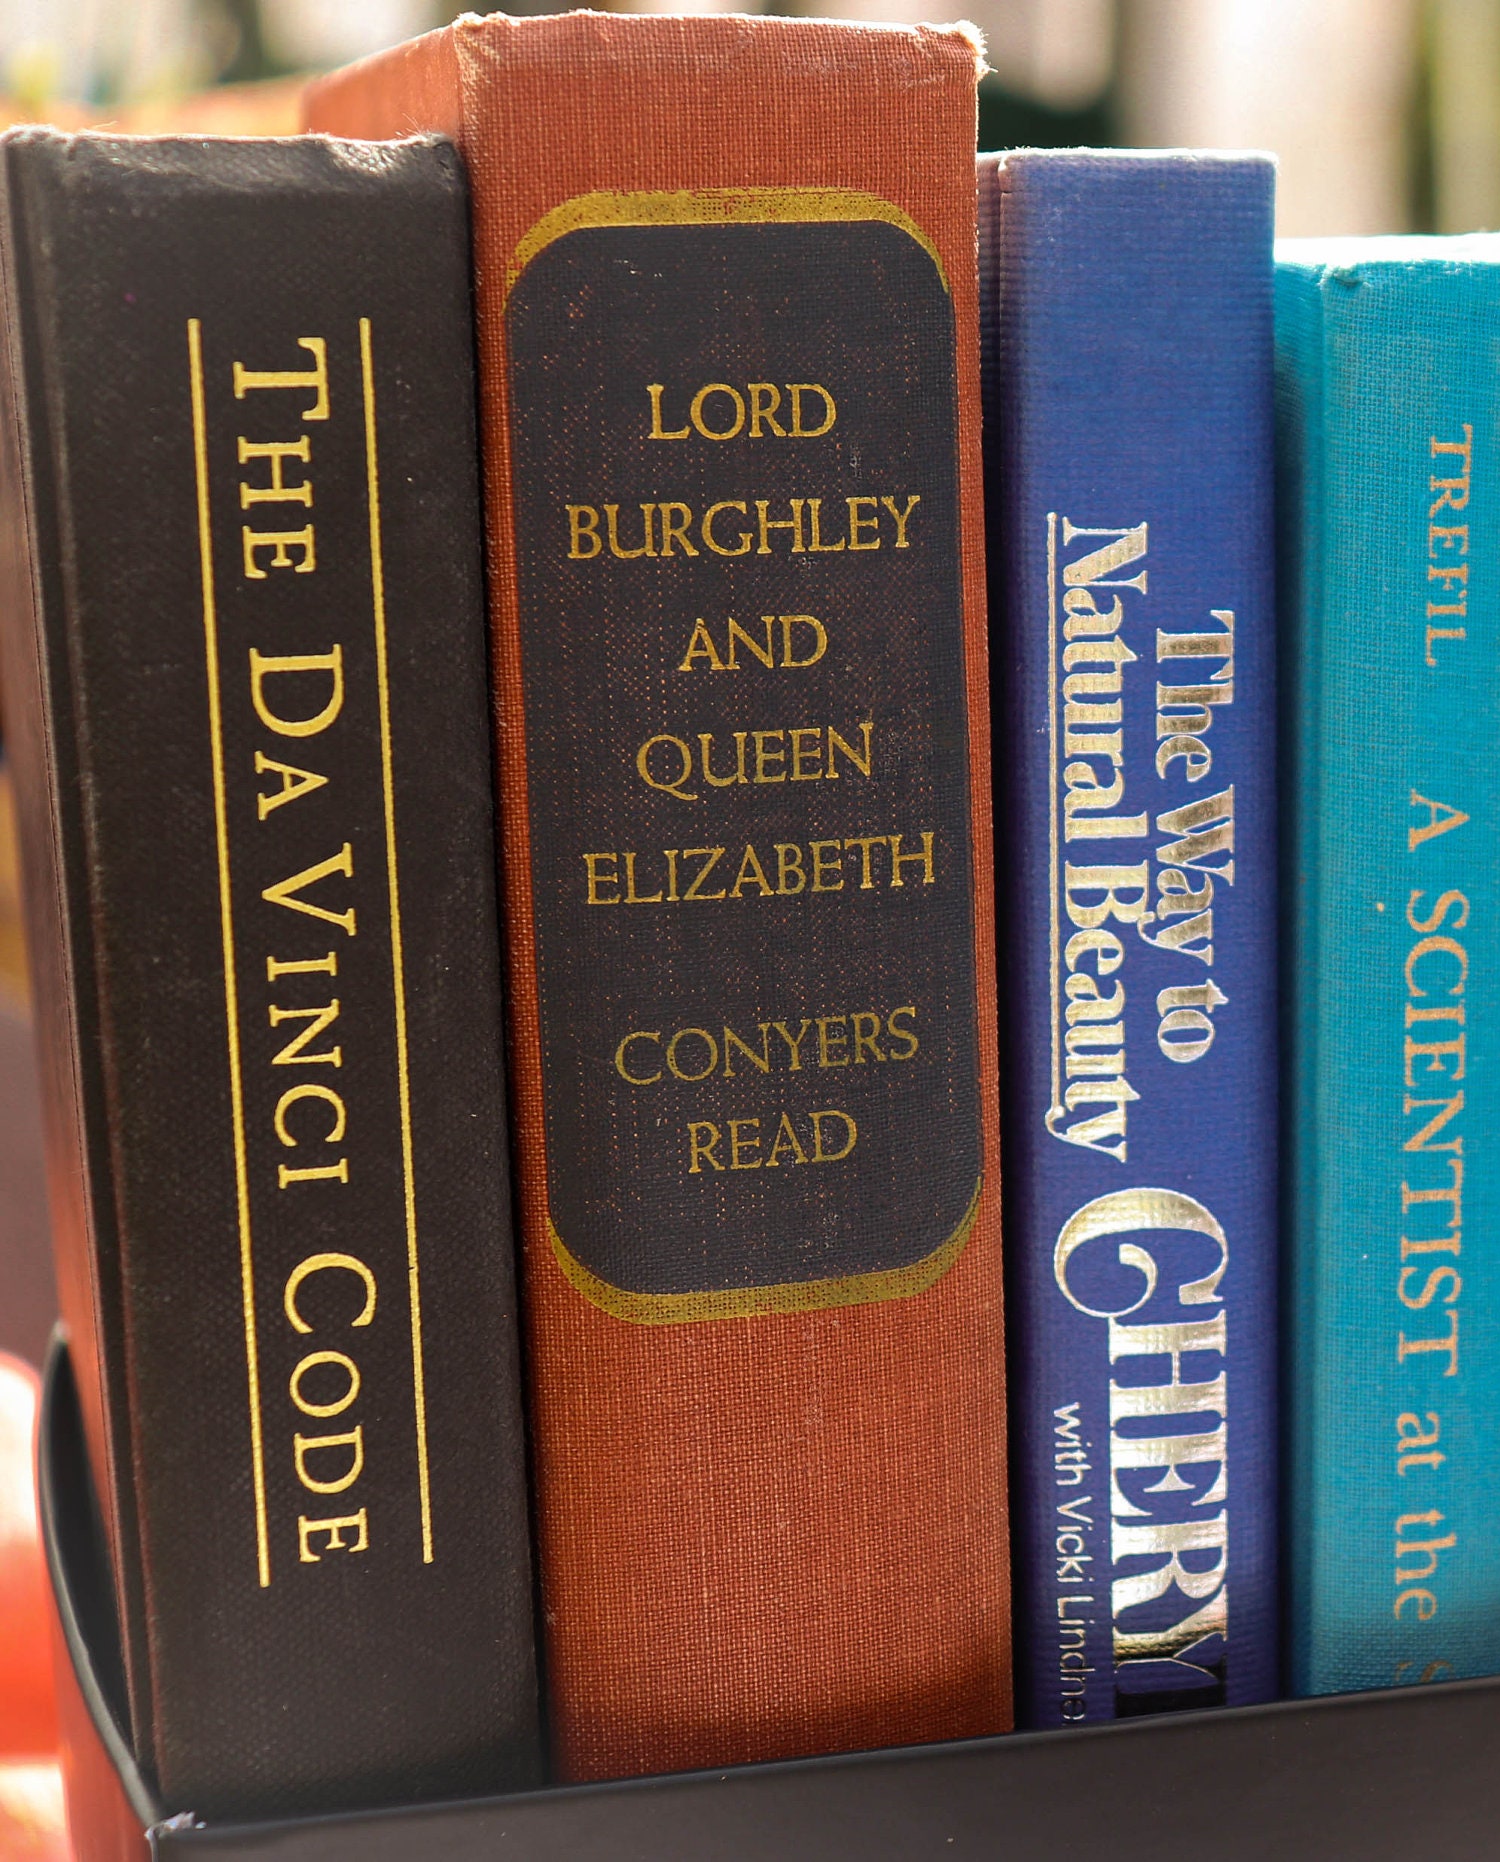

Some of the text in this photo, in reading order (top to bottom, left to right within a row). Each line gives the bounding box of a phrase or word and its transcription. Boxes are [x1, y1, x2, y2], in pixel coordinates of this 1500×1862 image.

[646, 383, 837, 441] LORD
[565, 495, 921, 560] BURGHLEY
[1425, 423, 1474, 668] TREFIL
[678, 614, 828, 673] AND
[636, 720, 875, 800] QUEEN
[1046, 516, 1150, 1163] Natural Beauty
[1138, 609, 1236, 1064] The Way to
[1407, 788, 1470, 852] A
[583, 831, 936, 905] ELIZABETH
[232, 337, 378, 1565] THE DA VINCI CODE
[614, 1006, 920, 1086] CONYERS
[687, 1109, 858, 1174] READ
[1397, 888, 1470, 1377] SCIENTIST
[1053, 1402, 1093, 1488] with
[1395, 1411, 1444, 1477] at
[1054, 1496, 1095, 1584] Vicki
[1394, 1508, 1458, 1621] the
